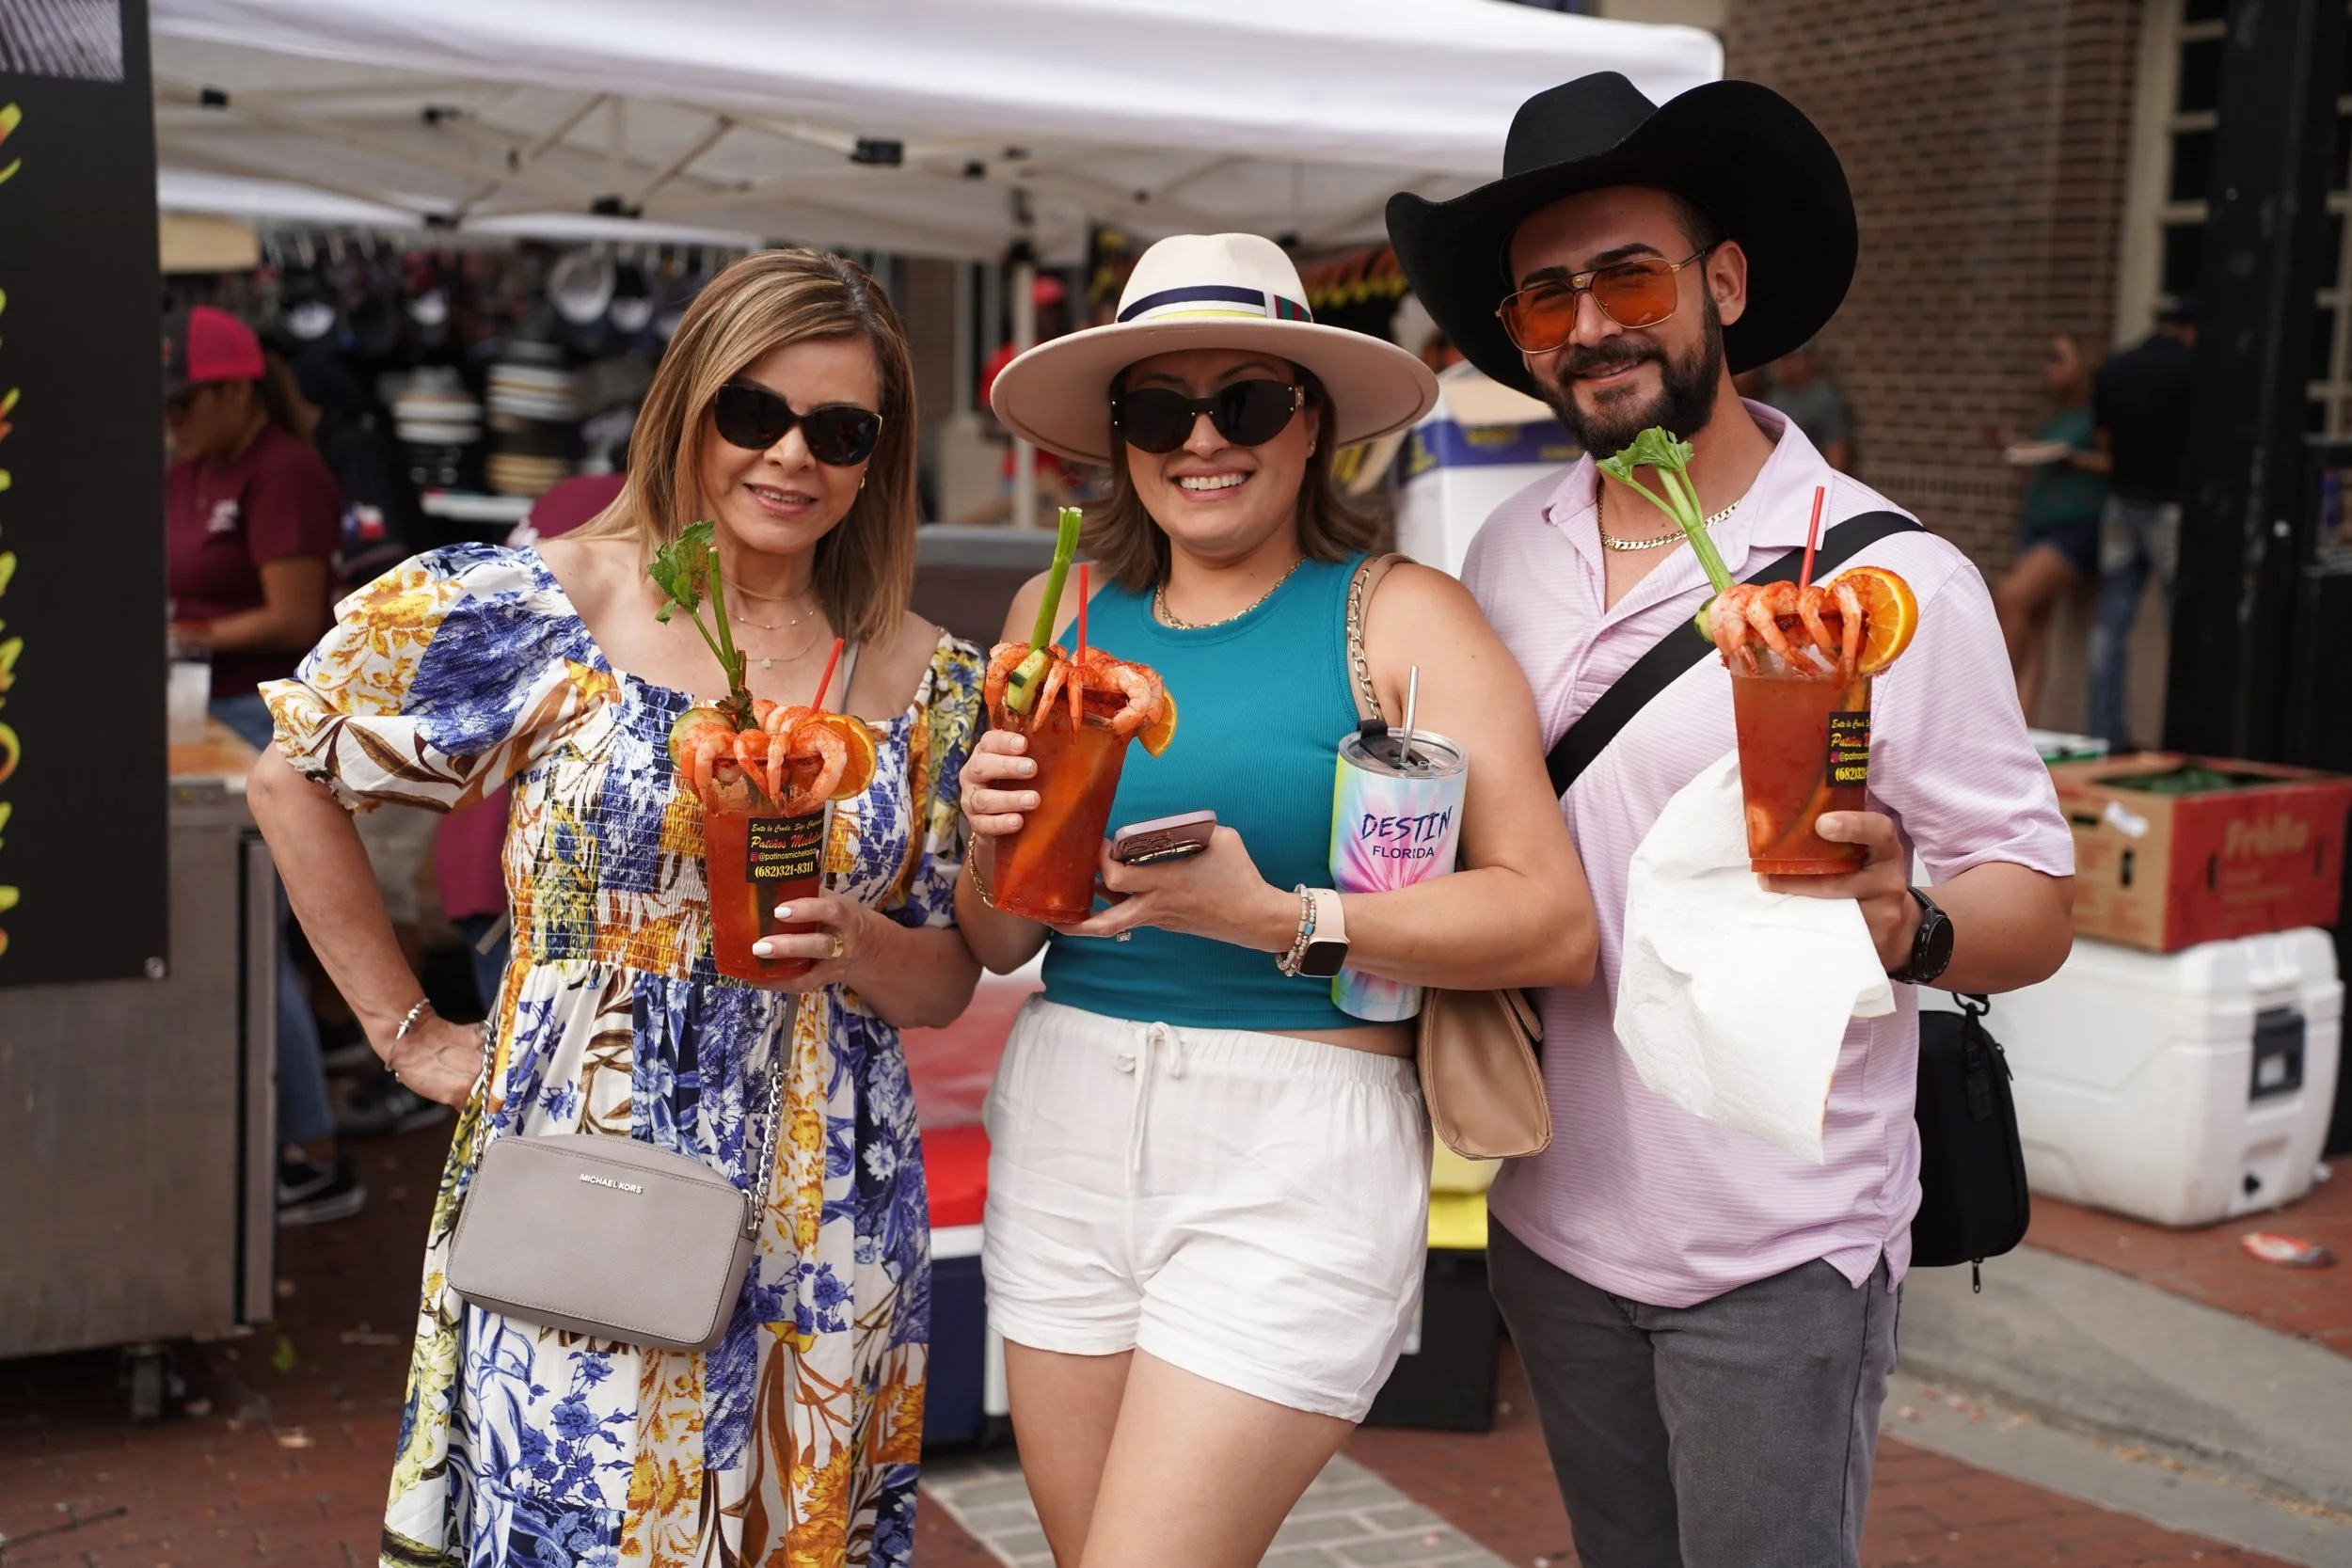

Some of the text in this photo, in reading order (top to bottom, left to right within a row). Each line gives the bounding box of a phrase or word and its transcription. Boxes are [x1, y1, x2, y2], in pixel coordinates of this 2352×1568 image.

[1360, 805, 1454, 843] DESTIN
[1372, 845, 1436, 860] FLORIDA
[755, 861, 814, 879] (682)321-8311
[580, 1173, 643, 1195] MICHAEL KORS
